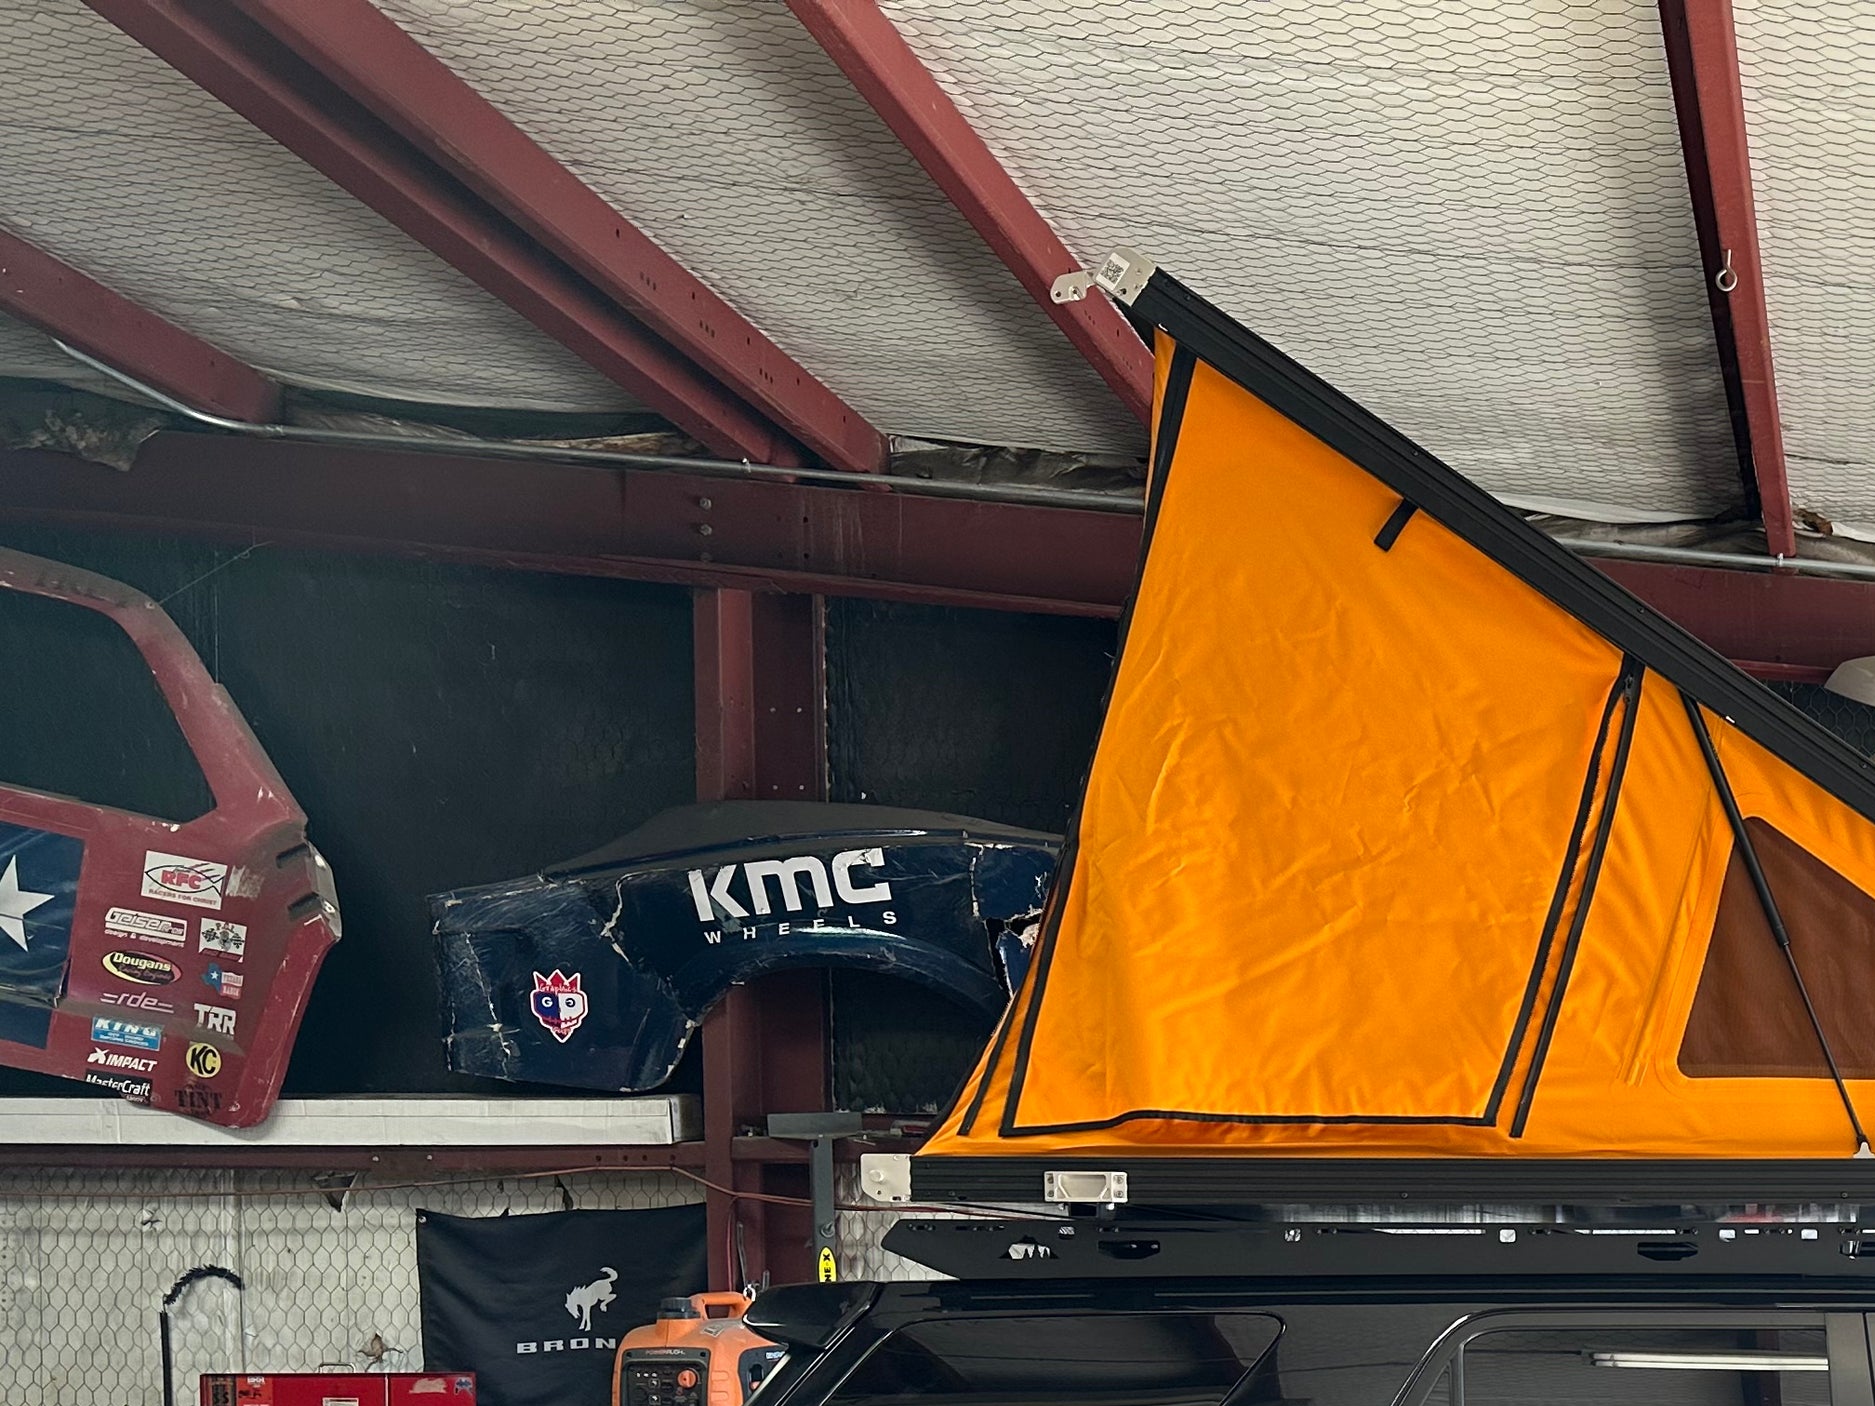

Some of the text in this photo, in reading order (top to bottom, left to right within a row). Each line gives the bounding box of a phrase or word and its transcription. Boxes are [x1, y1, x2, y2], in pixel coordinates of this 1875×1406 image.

[161, 870, 201, 889] RFC
[704, 911, 897, 944] WHEELS
[113, 952, 171, 972] Dougans
[190, 1046, 217, 1075] KC
[822, 1253, 832, 1283] NE-X
[516, 1338, 617, 1354] BRON
